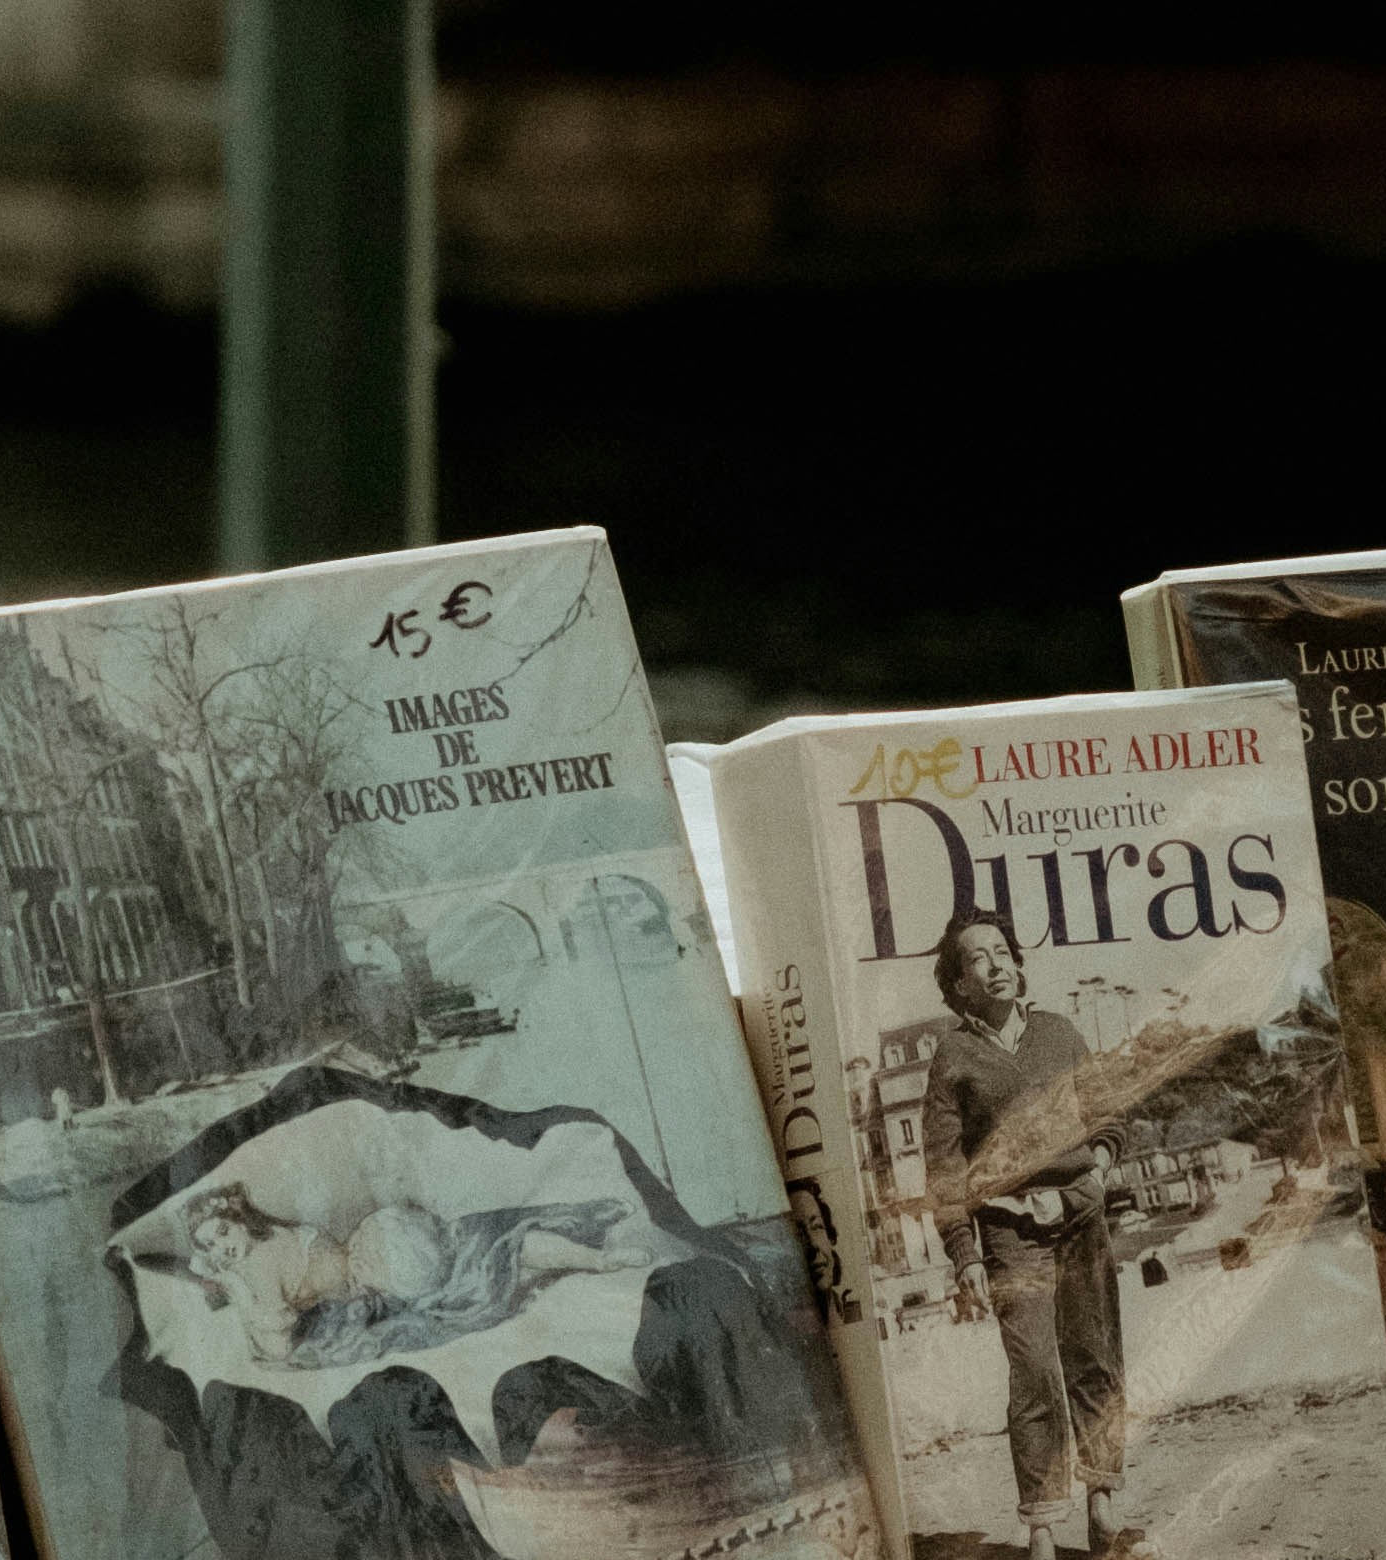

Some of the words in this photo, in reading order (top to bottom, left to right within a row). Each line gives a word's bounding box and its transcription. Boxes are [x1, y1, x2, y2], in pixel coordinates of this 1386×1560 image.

[370, 609, 431, 658] 15
[439, 581, 493, 629] €
[385, 684, 510, 734] IMAGES
[433, 730, 480, 768] DE
[970, 738, 1113, 784] LAURE
[1124, 726, 1265, 774] ADLER
[324, 774, 460, 834] JACQUES
[463, 752, 615, 807] PREVERT
[981, 792, 1169, 848] Marguerite
[838, 798, 1289, 963] Duras
[776, 963, 824, 1162] Duras
